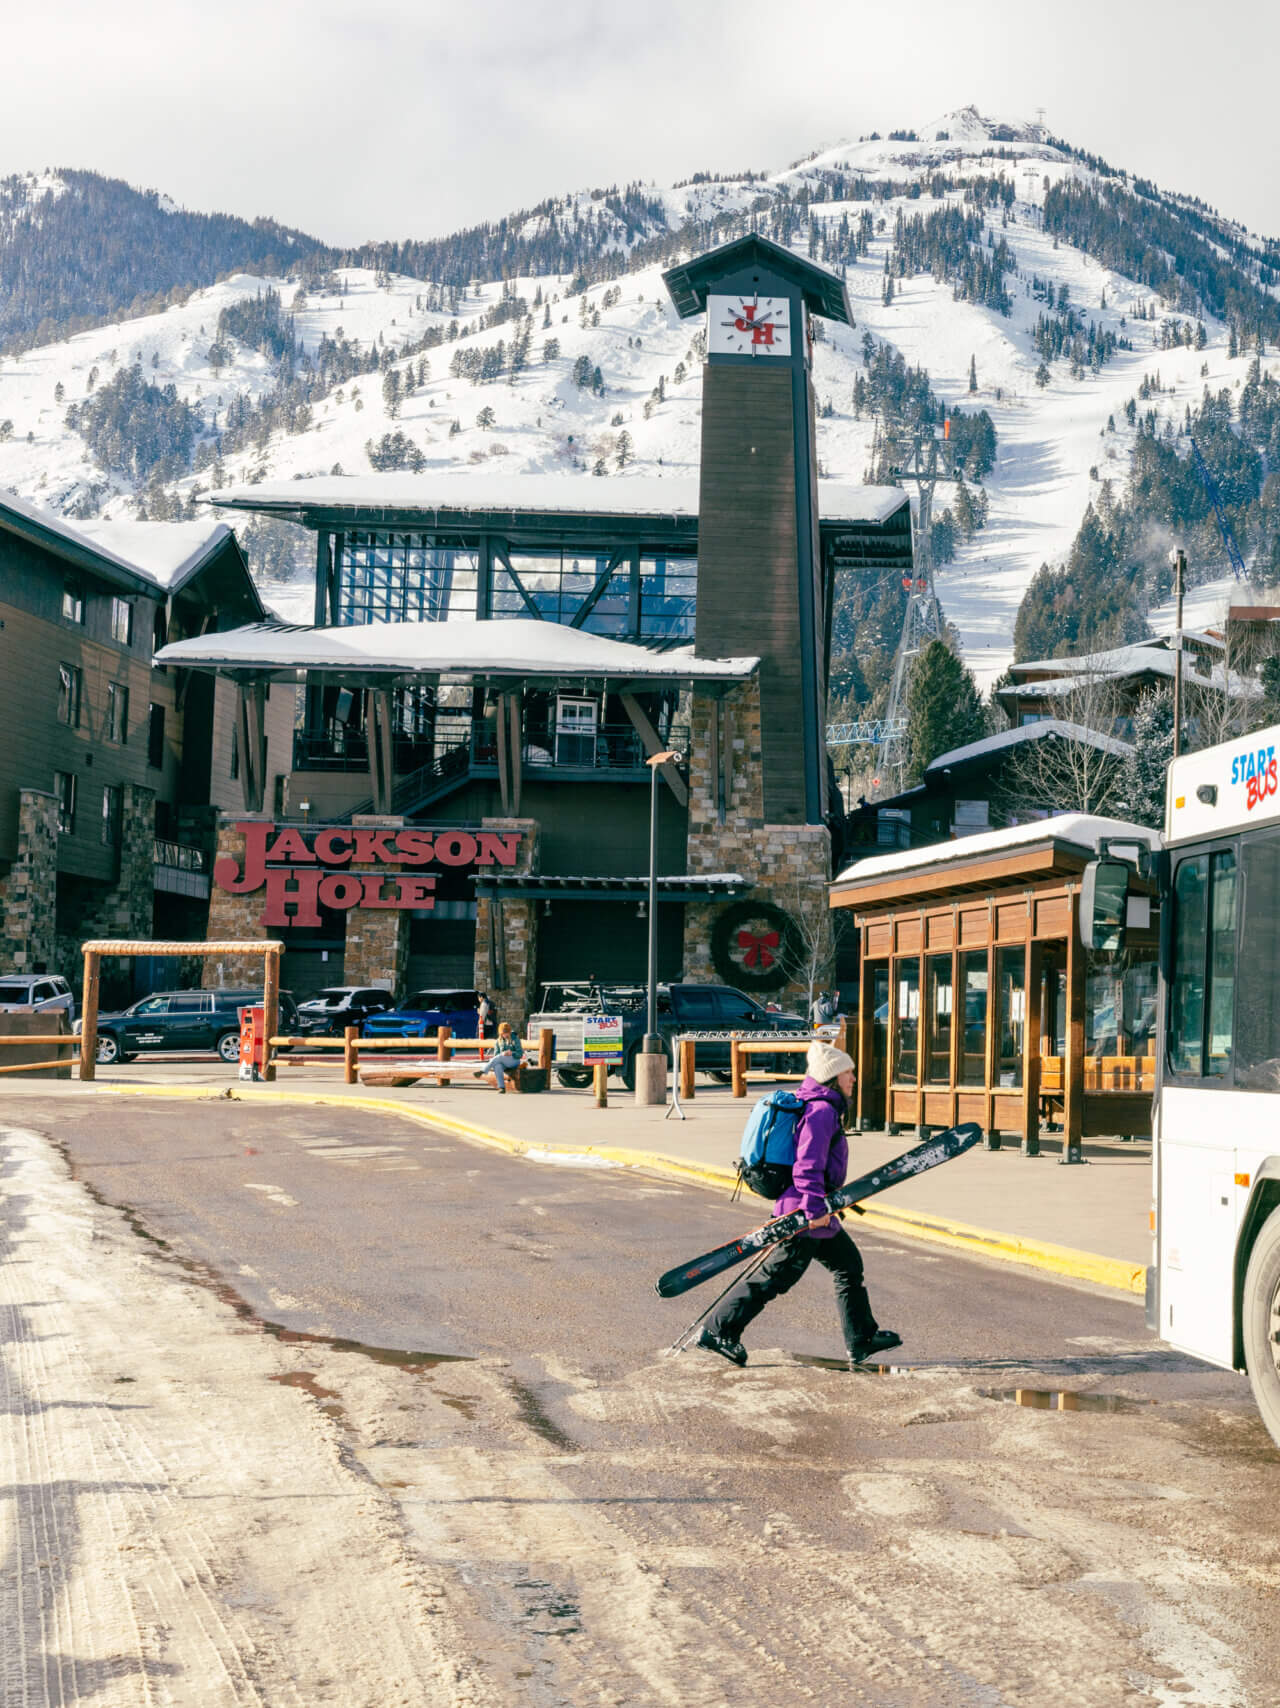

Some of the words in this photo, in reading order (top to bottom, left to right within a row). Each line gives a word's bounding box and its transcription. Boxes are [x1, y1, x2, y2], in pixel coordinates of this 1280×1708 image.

[1231, 745, 1275, 785] START
[1246, 758, 1278, 811] BUS
[213, 822, 522, 894] JACKSON
[260, 868, 437, 927] HOLE
[586, 1016, 617, 1024] START
